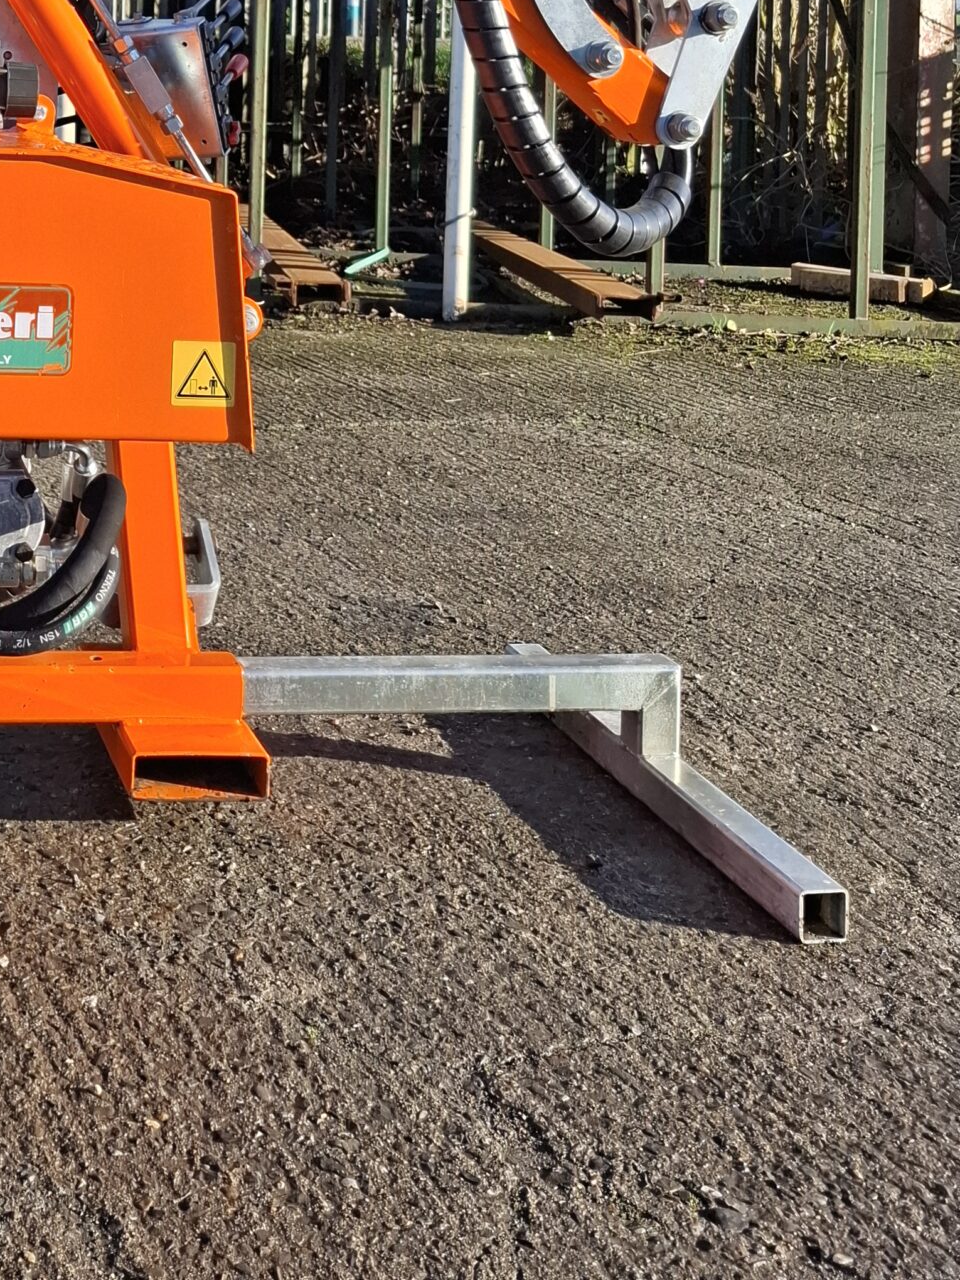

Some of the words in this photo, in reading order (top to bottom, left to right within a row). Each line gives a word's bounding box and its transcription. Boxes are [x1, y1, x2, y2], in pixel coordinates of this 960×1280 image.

[94, 569, 117, 602] TEKNO
[13, 638, 32, 649] 1/2"
[39, 629, 61, 644] 1SN
